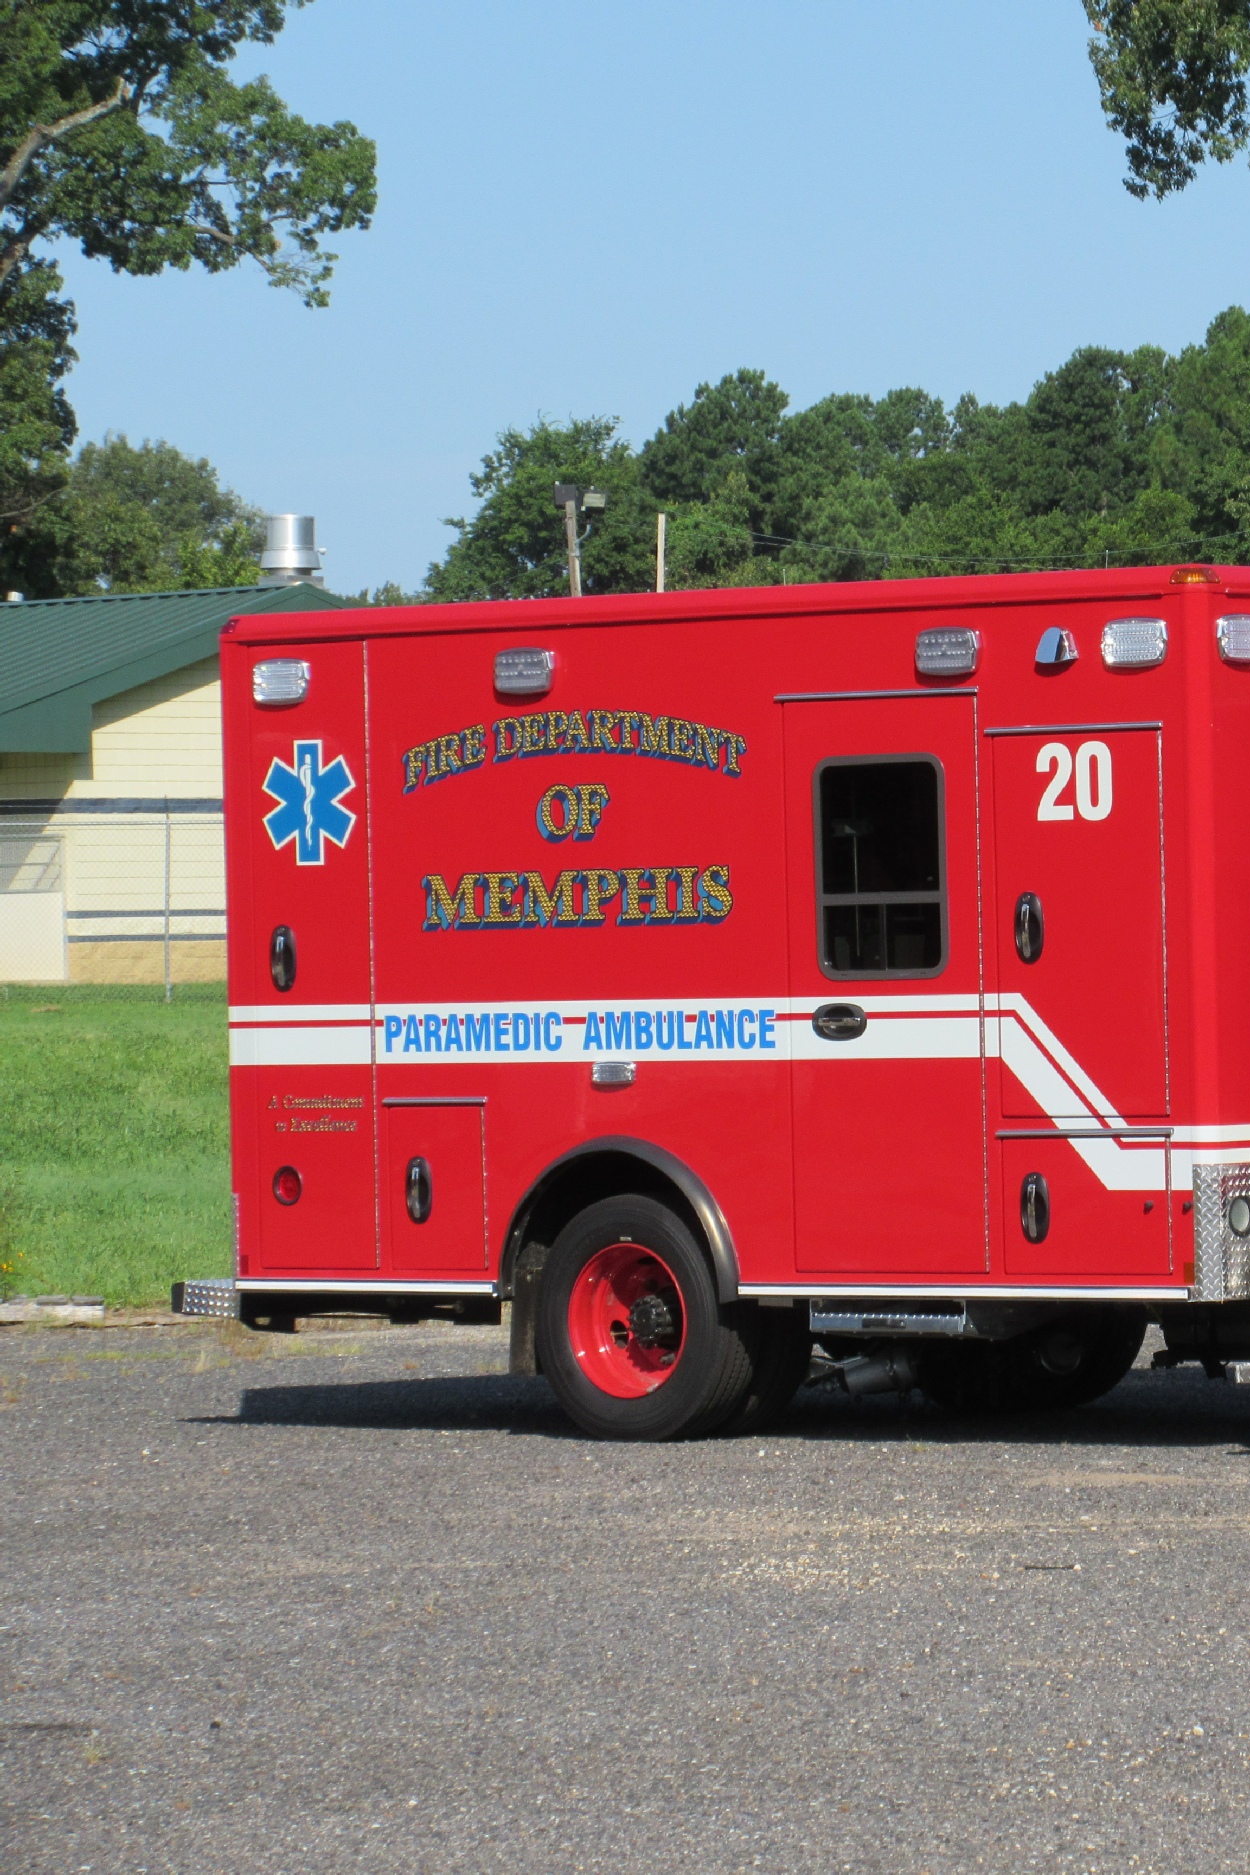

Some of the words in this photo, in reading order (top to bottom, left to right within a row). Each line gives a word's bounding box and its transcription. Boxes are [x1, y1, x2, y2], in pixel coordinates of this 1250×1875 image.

[402, 724, 487, 795] FIRE
[492, 710, 747, 778] DEPARTMENT
[1036, 740, 1113, 821] 20
[535, 783, 610, 843] OF
[421, 864, 734, 931] MEMPHIS
[384, 1011, 563, 1052] PARAMEDIC
[583, 1009, 776, 1051] AMBULANCE
